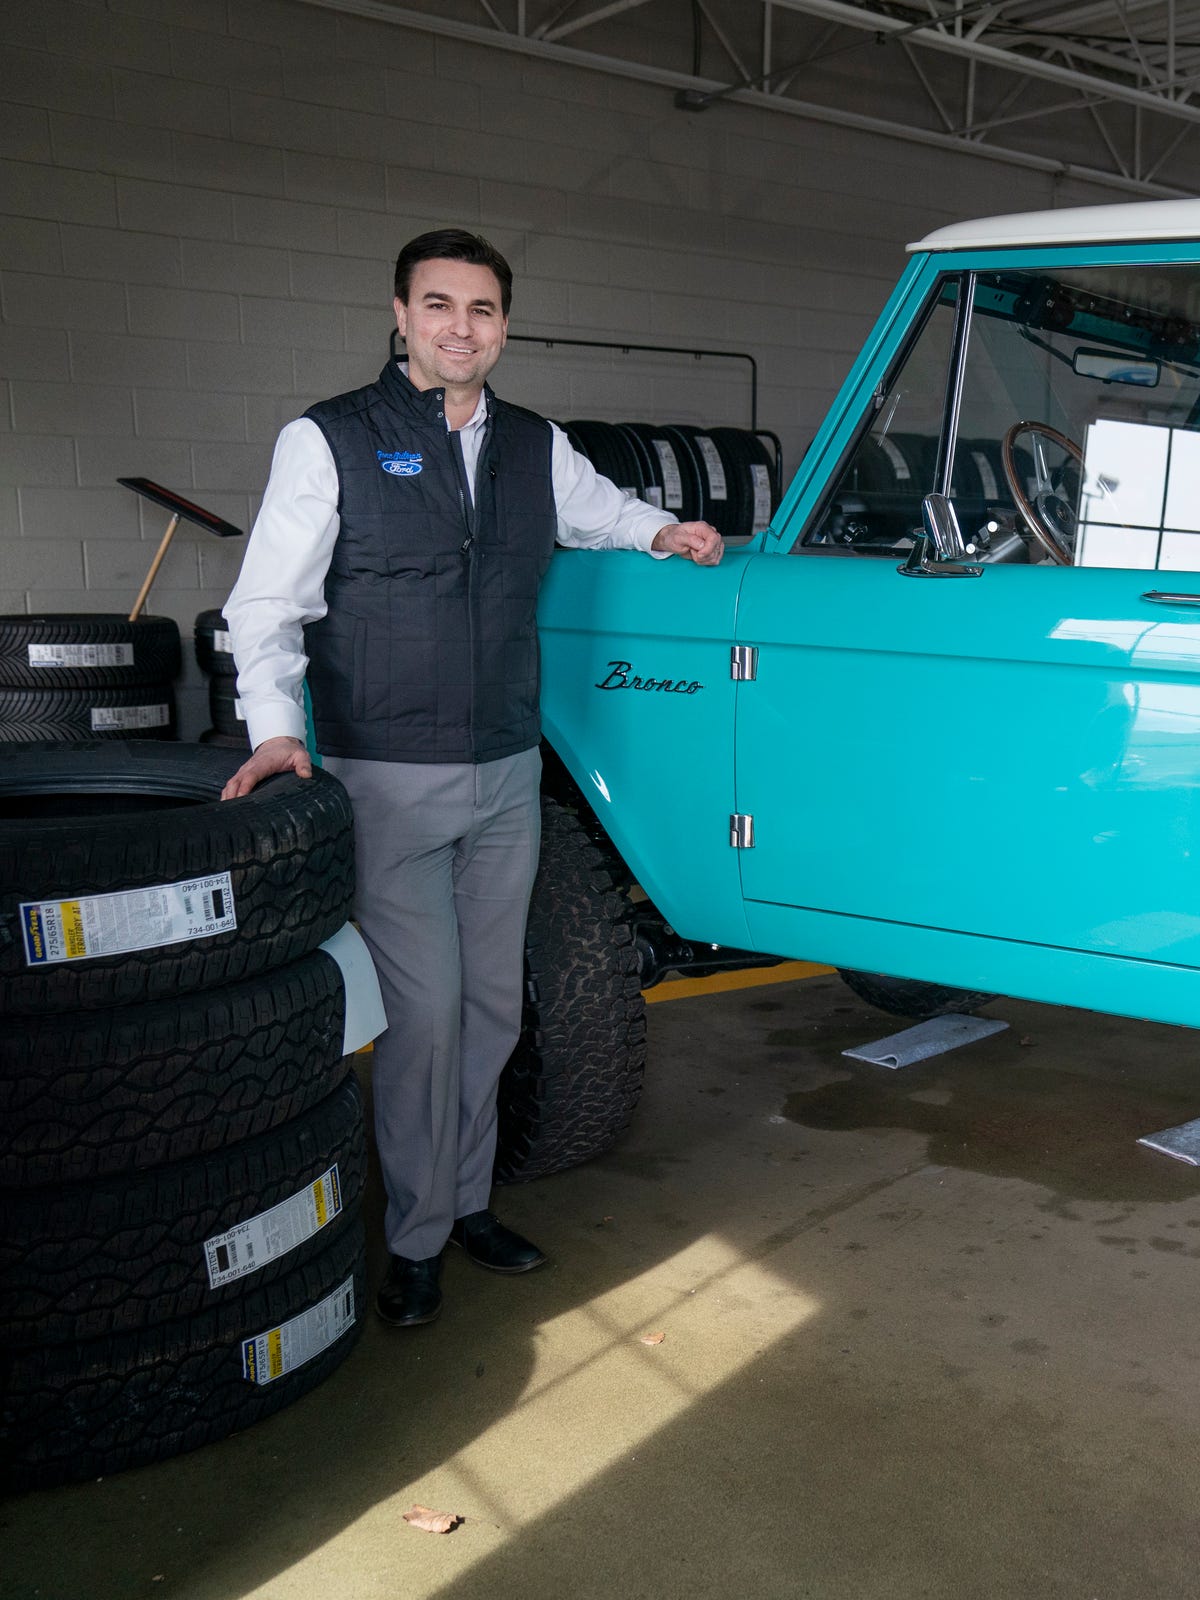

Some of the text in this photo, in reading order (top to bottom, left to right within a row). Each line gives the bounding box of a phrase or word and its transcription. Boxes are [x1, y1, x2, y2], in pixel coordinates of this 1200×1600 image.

[390, 462, 414, 474] Ford
[595, 661, 704, 695] Bronco
[182, 876, 229, 892] 734-001-640
[29, 910, 42, 958] GOODYEAR
[45, 908, 60, 956] 275/65R18
[72, 906, 86, 954] TERRITORY AT
[187, 919, 235, 935] 734-001-640
